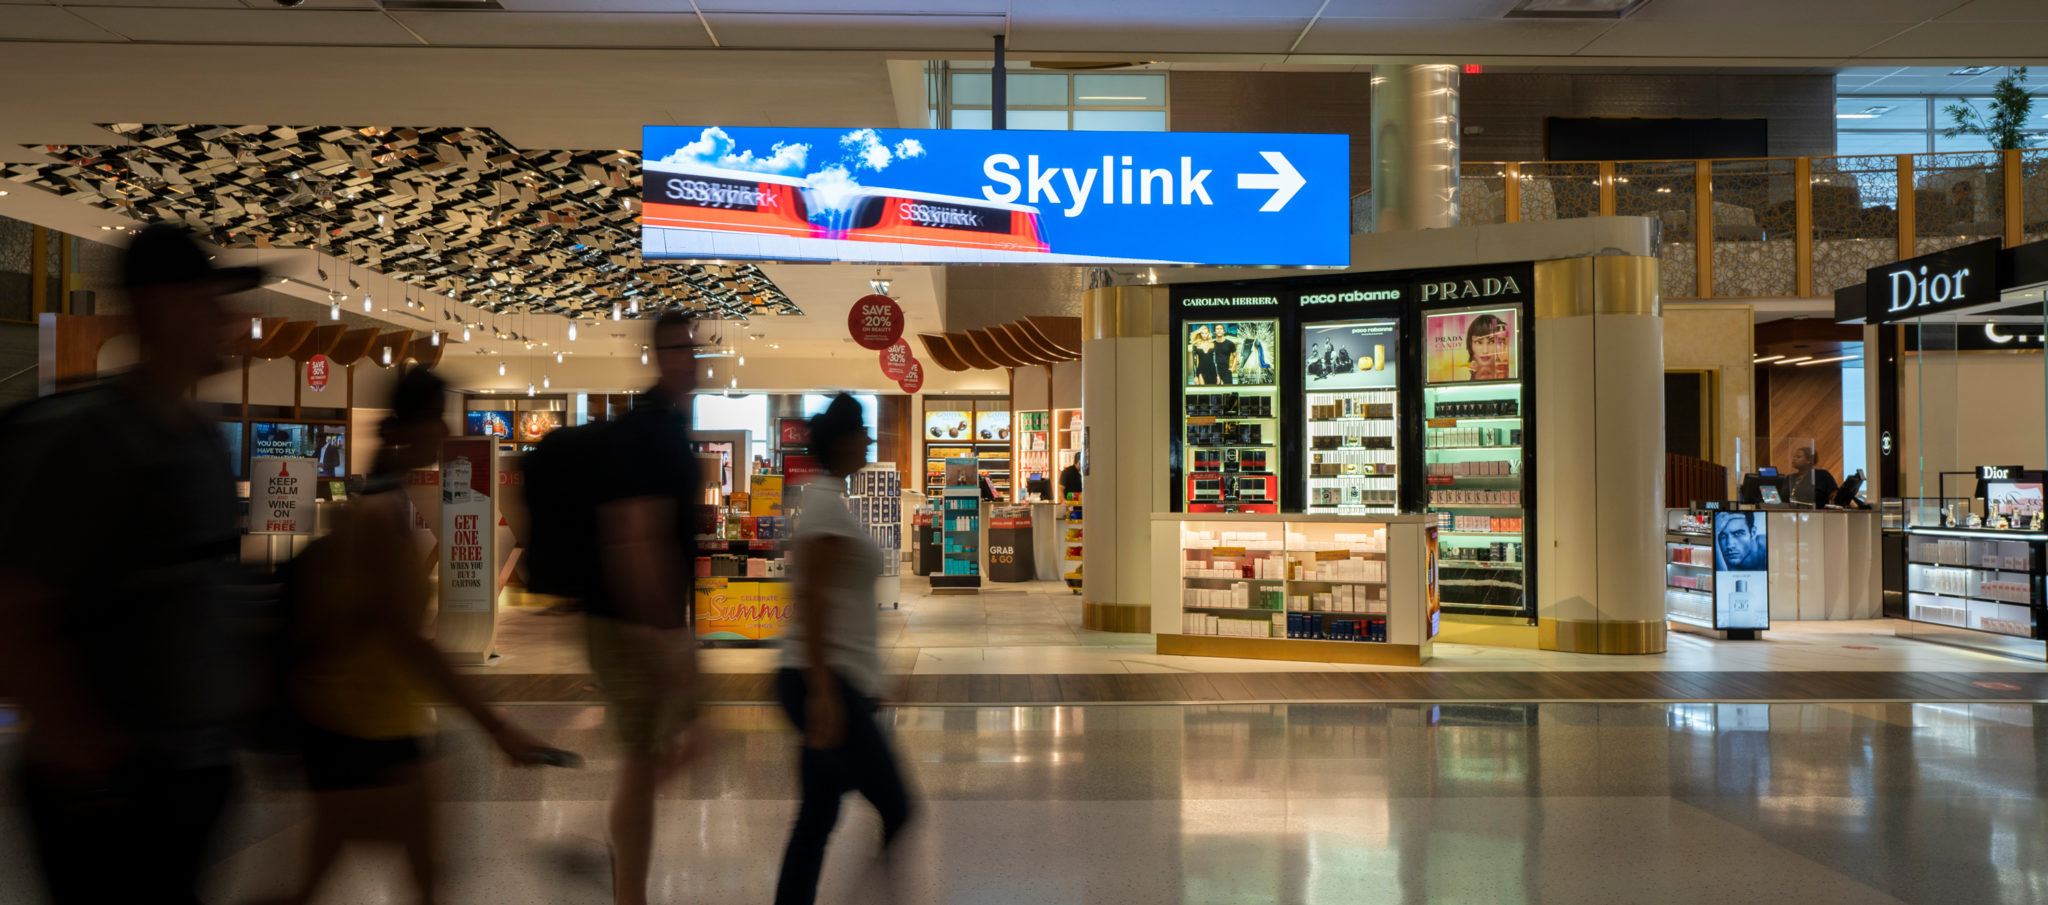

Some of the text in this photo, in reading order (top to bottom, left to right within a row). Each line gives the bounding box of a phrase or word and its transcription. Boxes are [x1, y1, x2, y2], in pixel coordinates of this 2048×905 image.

[981, 153, 1213, 218] Skylink
[1420, 275, 1521, 301] PRADA
[1888, 265, 1971, 313] Dior
[1183, 296, 1279, 307] CAROLINA HERRERA
[1300, 289, 1401, 306] paco rabanne
[862, 304, 892, 315] SAVE
[1435, 335, 1463, 343] PRADA
[888, 345, 905, 353] SAVE
[1983, 466, 2009, 479] Dior
[269, 478, 297, 486] KEEP
[268, 486, 298, 495] CALM
[268, 500, 296, 509] WINE
[273, 509, 290, 518] ON
[454, 514, 479, 530] GET
[266, 523, 297, 532] FREE
[454, 530, 479, 546] ONE
[451, 546, 482, 561] FREE
[989, 546, 1014, 555] GRAB
[990, 555, 1014, 564] & GO
[450, 562, 483, 570] WHEN YOU
[457, 571, 470, 579] BUY
[451, 579, 481, 588] CARTONS
[704, 594, 793, 621] Summe
